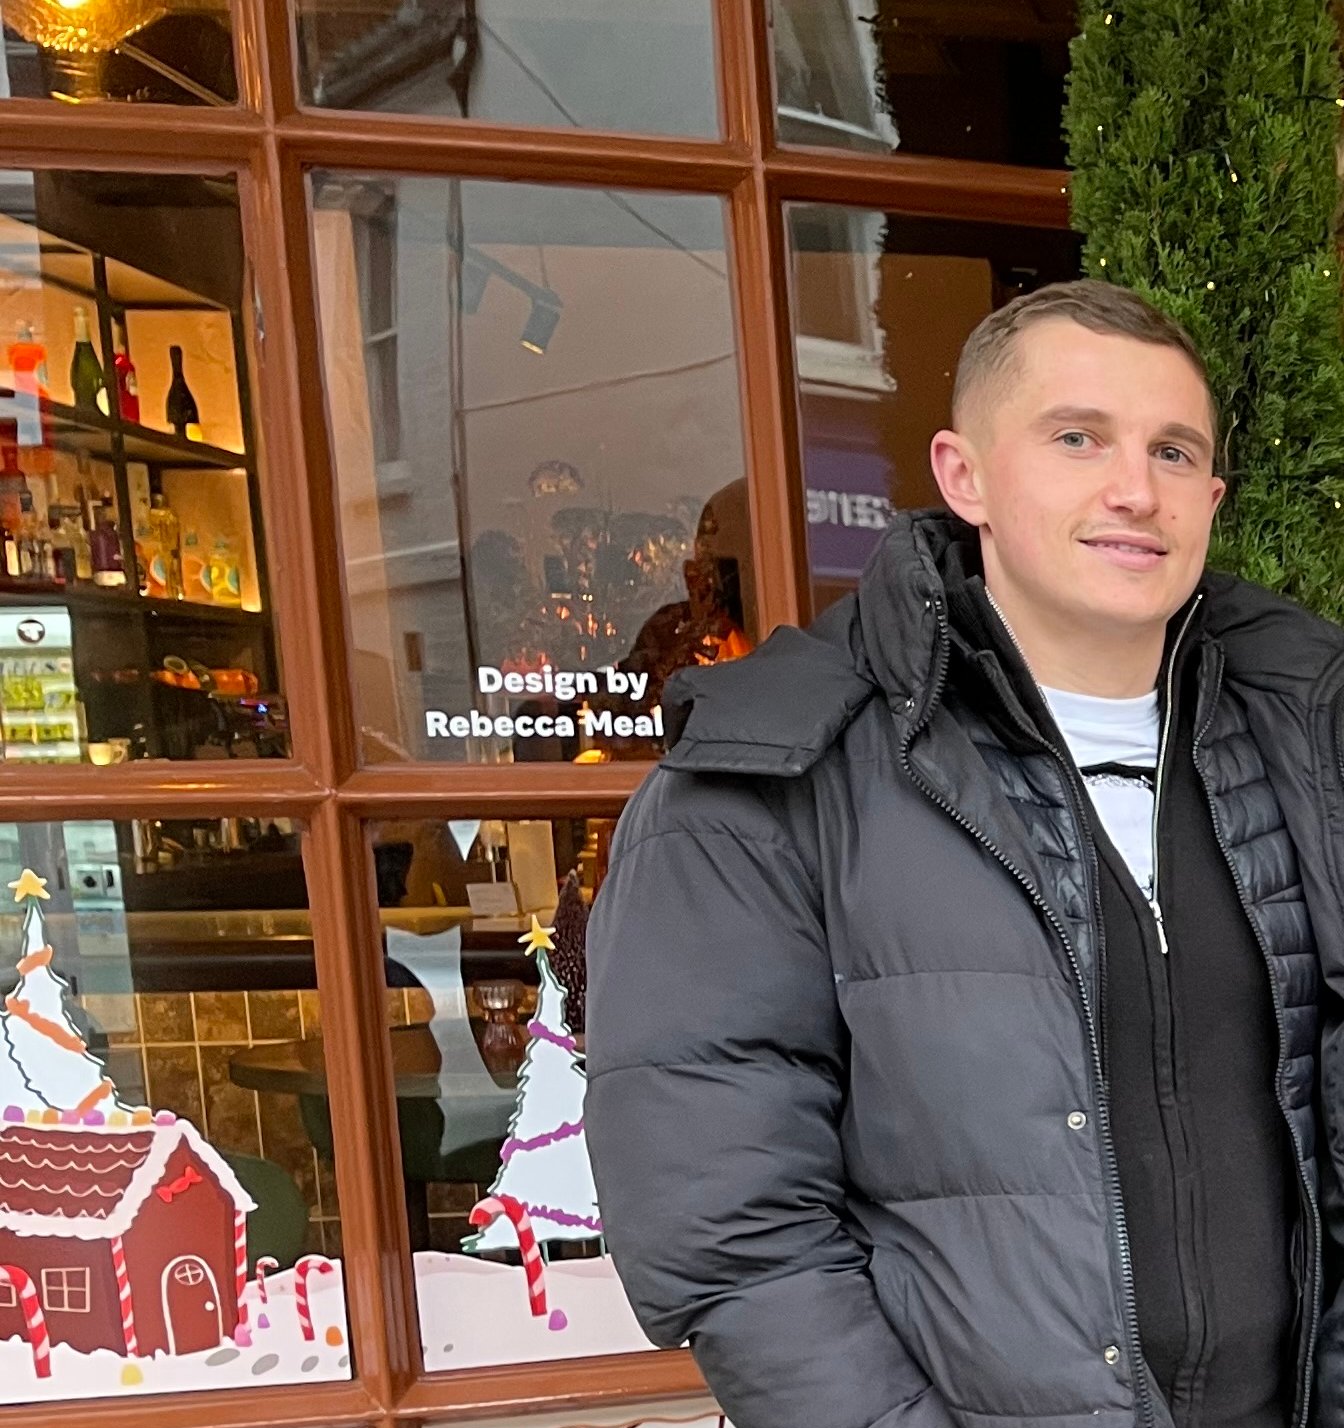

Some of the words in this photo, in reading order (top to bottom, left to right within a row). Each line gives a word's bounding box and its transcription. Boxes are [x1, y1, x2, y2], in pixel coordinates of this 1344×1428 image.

[477, 664, 598, 700] Design
[606, 666, 649, 700] by
[425, 710, 575, 737] Rebecca
[584, 705, 664, 737] Meal
